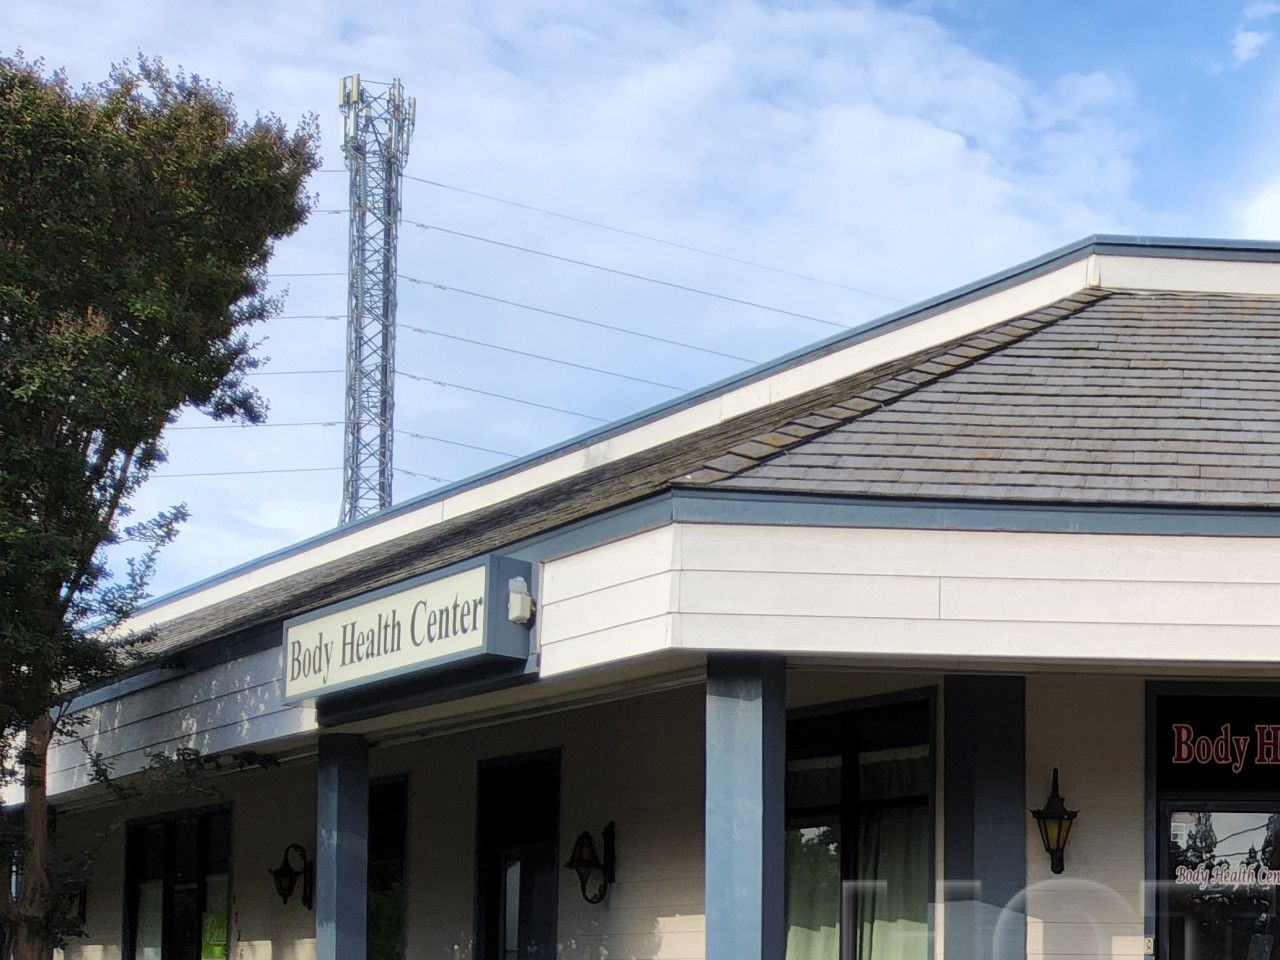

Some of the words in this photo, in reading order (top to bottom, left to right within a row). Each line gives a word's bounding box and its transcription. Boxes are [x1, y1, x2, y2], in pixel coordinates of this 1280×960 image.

[289, 632, 334, 684] Body
[339, 609, 402, 667] Health
[410, 593, 483, 647] Center
[1172, 723, 1249, 774] Body
[1175, 864, 1210, 891] Body
[1211, 863, 1256, 885] Health
